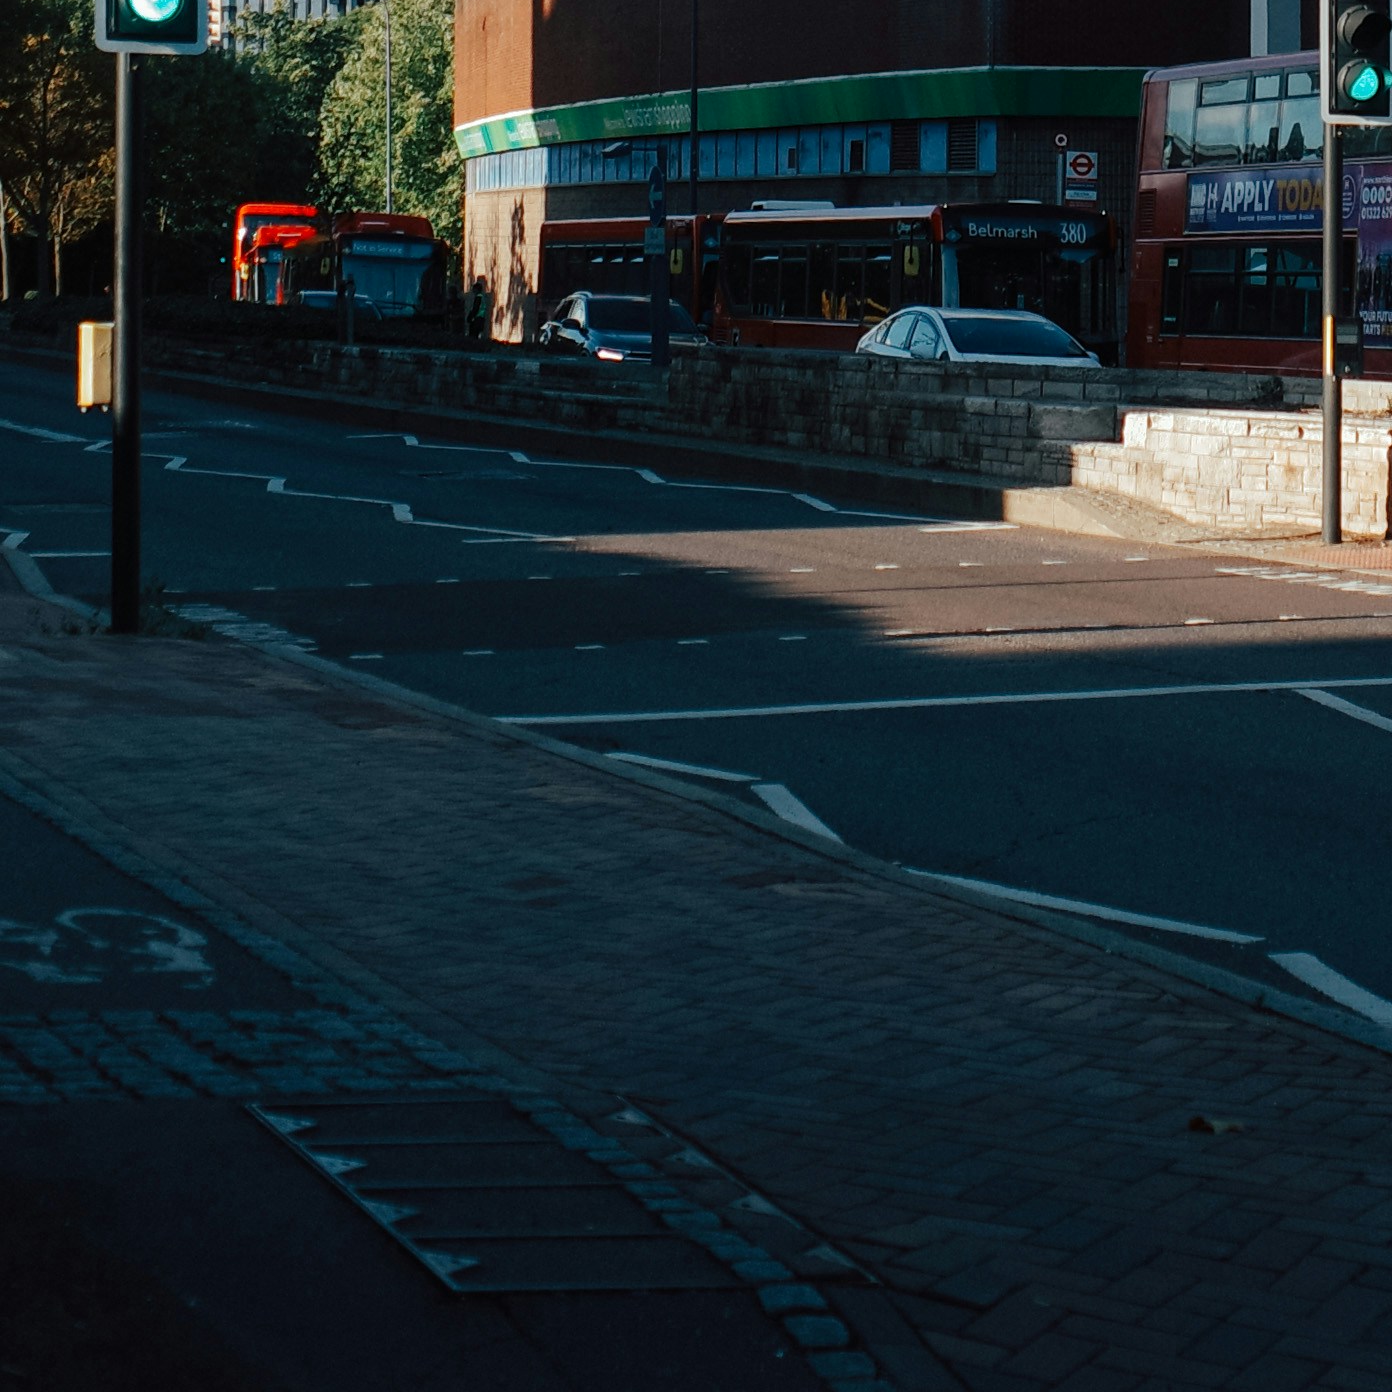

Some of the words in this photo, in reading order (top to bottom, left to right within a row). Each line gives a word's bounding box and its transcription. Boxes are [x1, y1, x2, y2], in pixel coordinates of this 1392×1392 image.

[653, 99, 691, 129] shoppin
[1220, 178, 1275, 214] APPLY
[1276, 178, 1324, 212] TODA
[1361, 206, 1381, 220] 01322
[968, 222, 1038, 240] Belmarsh
[1058, 221, 1087, 245] 380
[352, 242, 367, 252] Not
[1359, 310, 1376, 322] YOUR
[1363, 323, 1380, 336] TARTS
